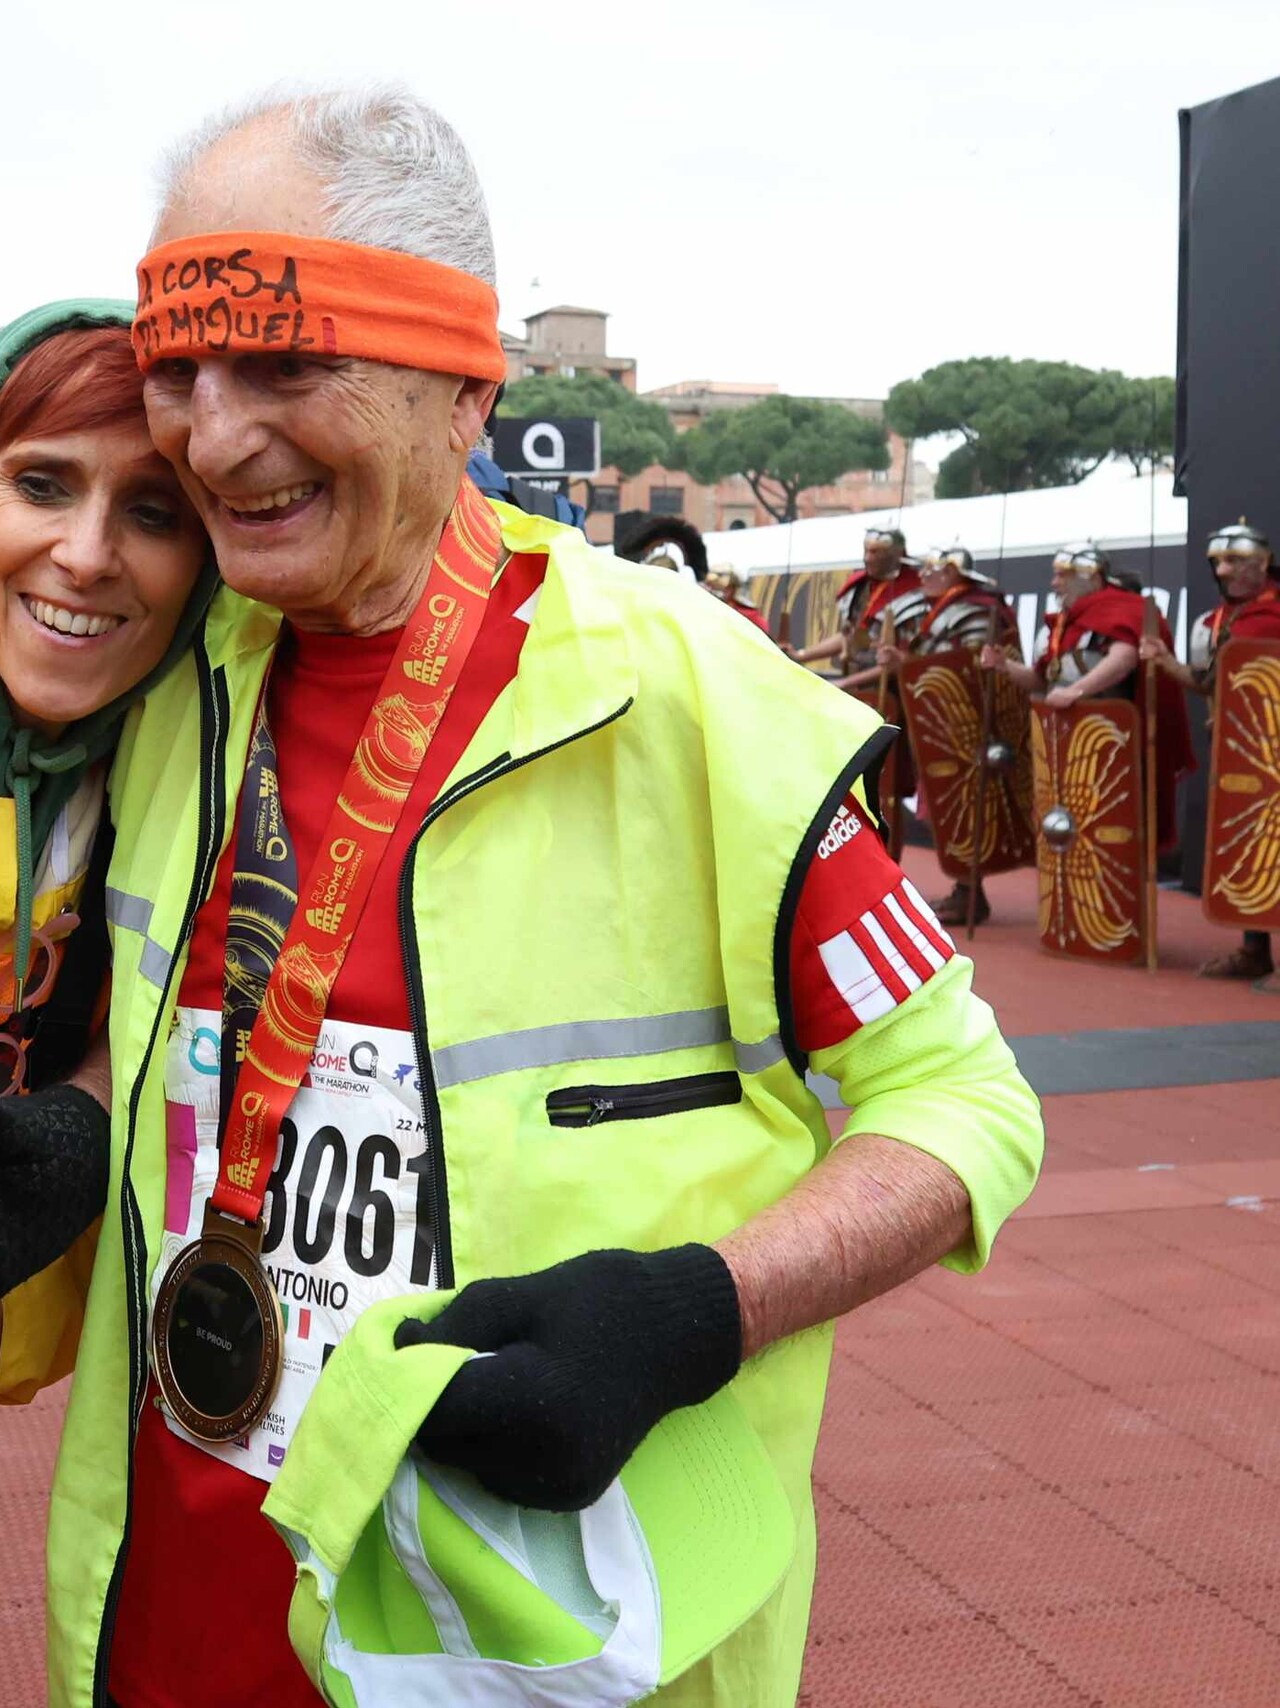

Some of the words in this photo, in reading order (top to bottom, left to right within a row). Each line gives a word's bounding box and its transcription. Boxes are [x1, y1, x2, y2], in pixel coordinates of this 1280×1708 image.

[162, 248, 302, 304] CORSA
[408, 625, 429, 656] RUN
[422, 618, 446, 658] ROME
[269, 794, 279, 836] ROME
[817, 813, 862, 860] adidas
[323, 863, 346, 906] ROME
[326, 1078, 370, 1094] MARATHON
[240, 1118, 255, 1160] ROME
[395, 1119, 413, 1131] 22
[267, 1265, 349, 1311] NTONIO
[207, 1331, 233, 1351] PROUD
[260, 1421, 285, 1436] LINES
[266, 1412, 286, 1426] KISH
